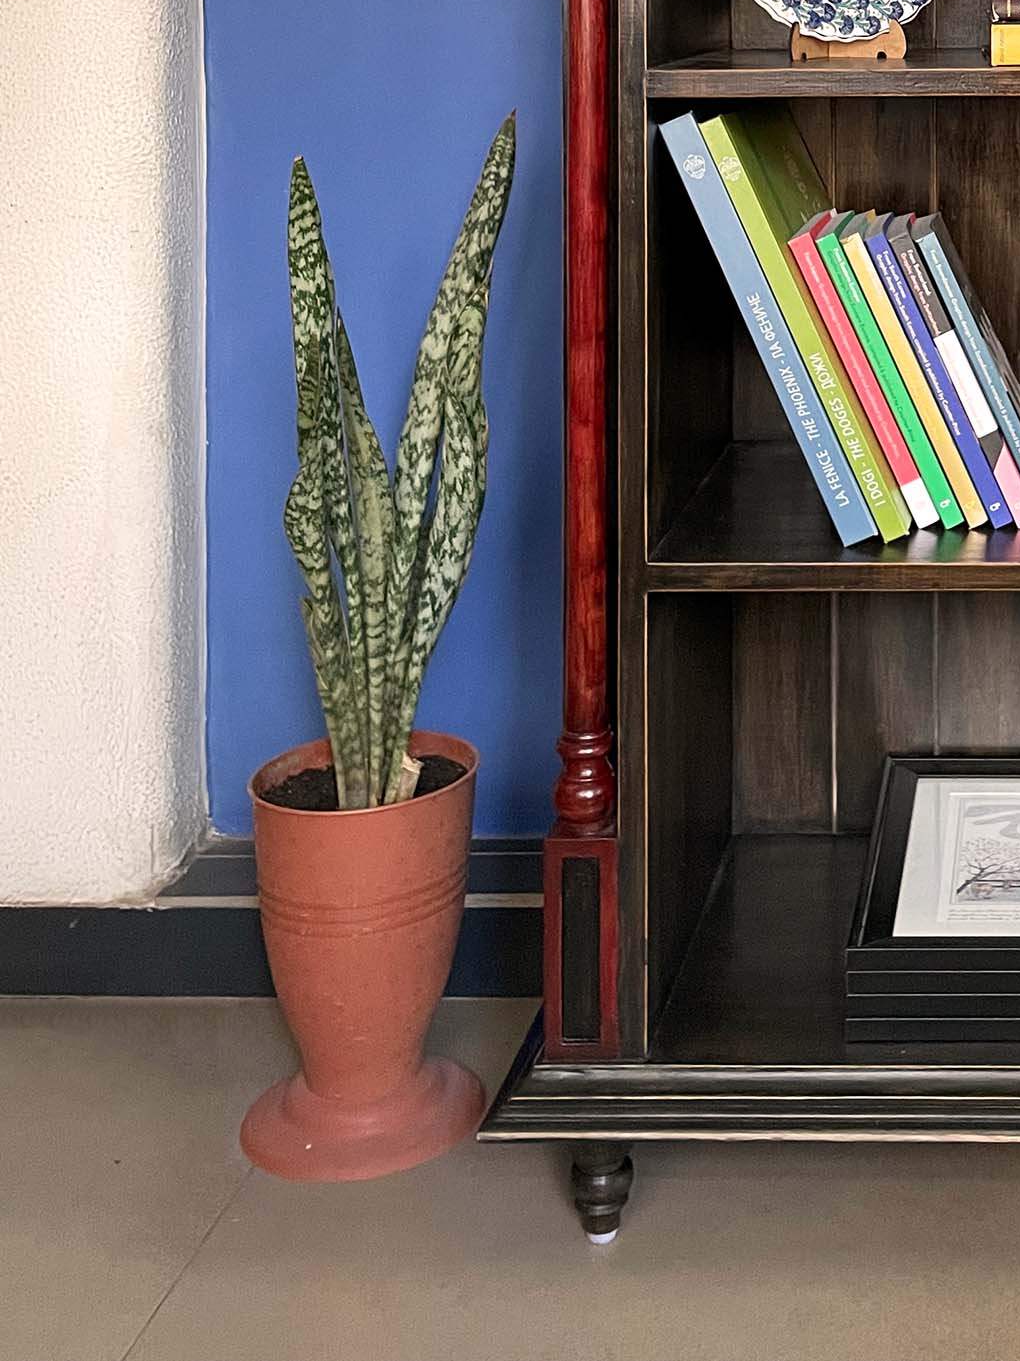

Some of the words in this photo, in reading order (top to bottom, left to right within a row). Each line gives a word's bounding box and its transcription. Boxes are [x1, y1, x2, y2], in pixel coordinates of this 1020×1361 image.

[745, 292, 777, 342] ФЕНИЧЕ
[777, 364, 811, 418] PHOENIX
[808, 351, 836, 391] ДОЖИ
[801, 417, 821, 440] THE
[827, 396, 855, 437] DOGES
[845, 436, 865, 460] THE
[815, 449, 842, 490] FENICE
[860, 468, 883, 500] DOGI
[833, 489, 850, 508] LA
